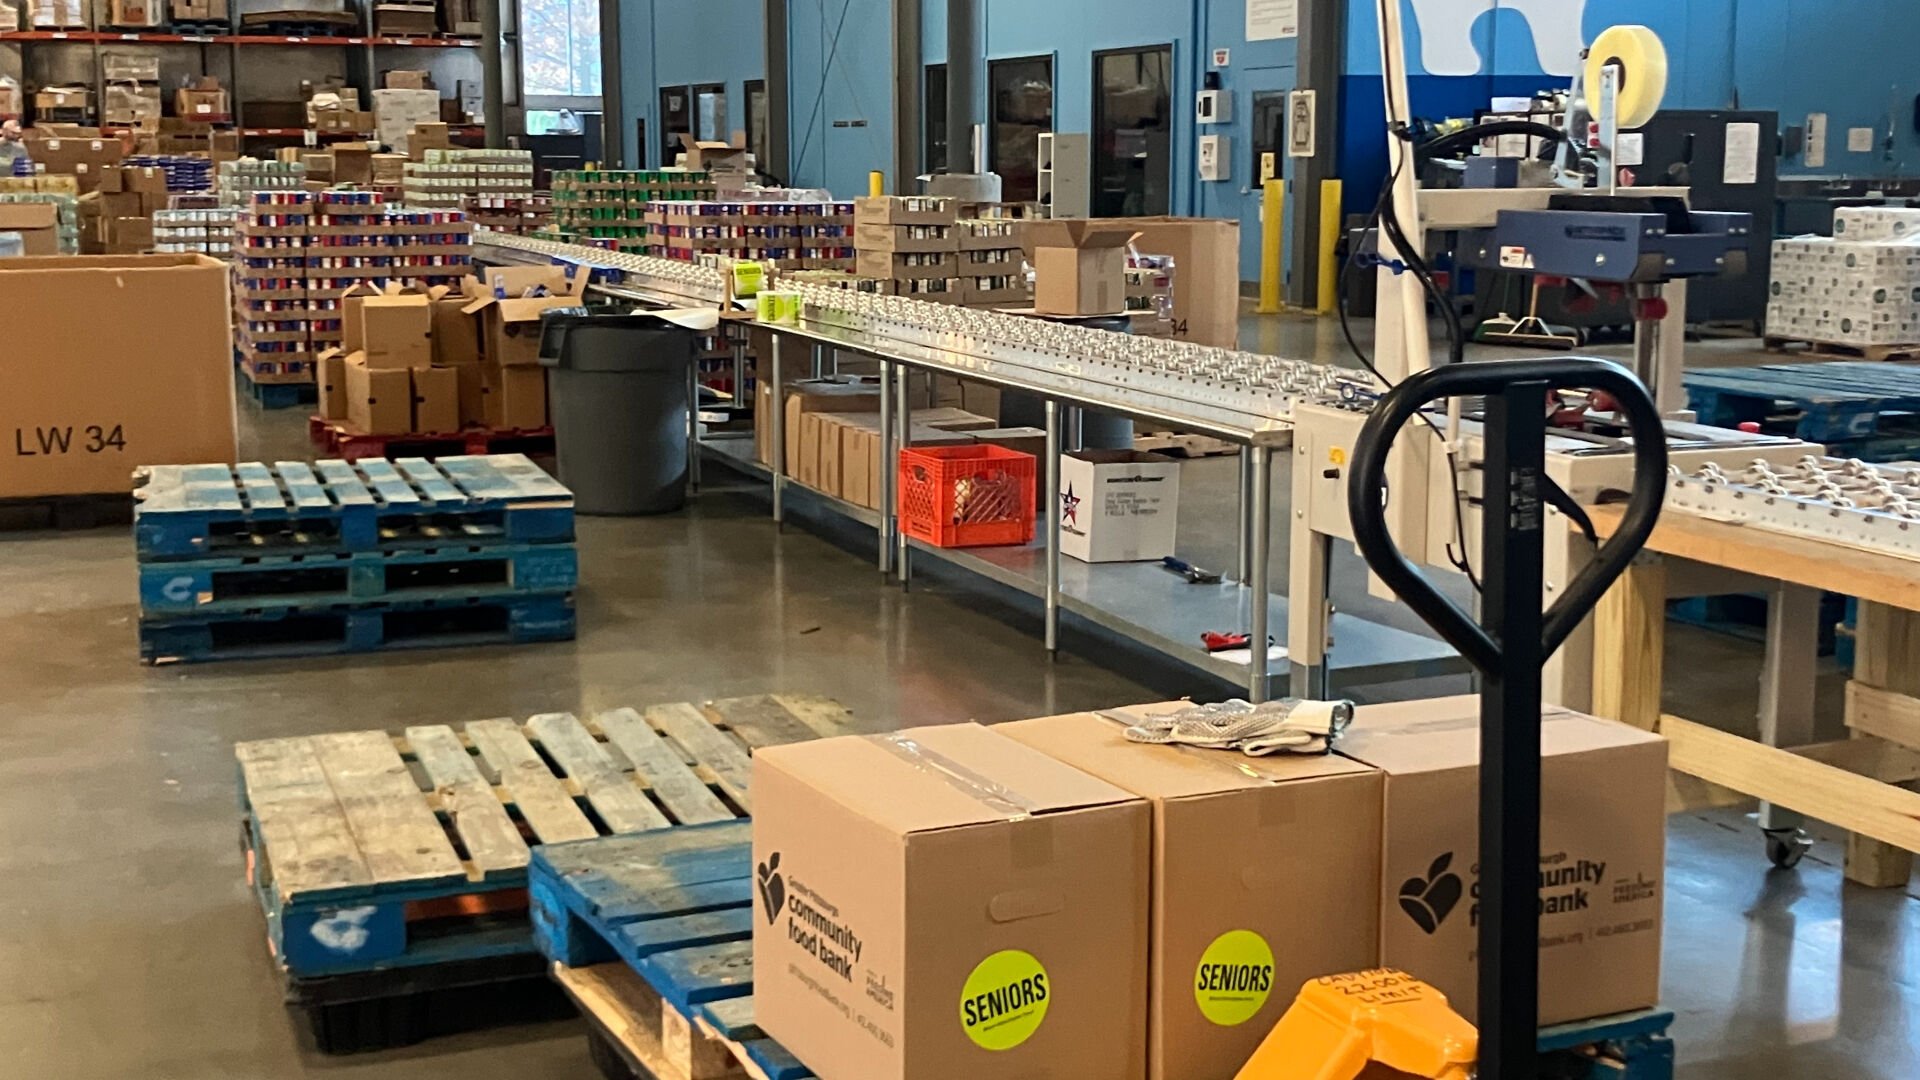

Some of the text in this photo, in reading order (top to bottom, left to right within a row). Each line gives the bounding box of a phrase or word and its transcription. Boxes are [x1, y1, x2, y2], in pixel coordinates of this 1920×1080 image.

[16, 424, 127, 456] LW 34
[788, 893, 862, 963] community
[788, 916, 853, 983] food bank
[1198, 963, 1272, 992] SENIORS
[1358, 985, 1422, 1004] LIMIT
[964, 973, 1047, 1027] SENIORS
